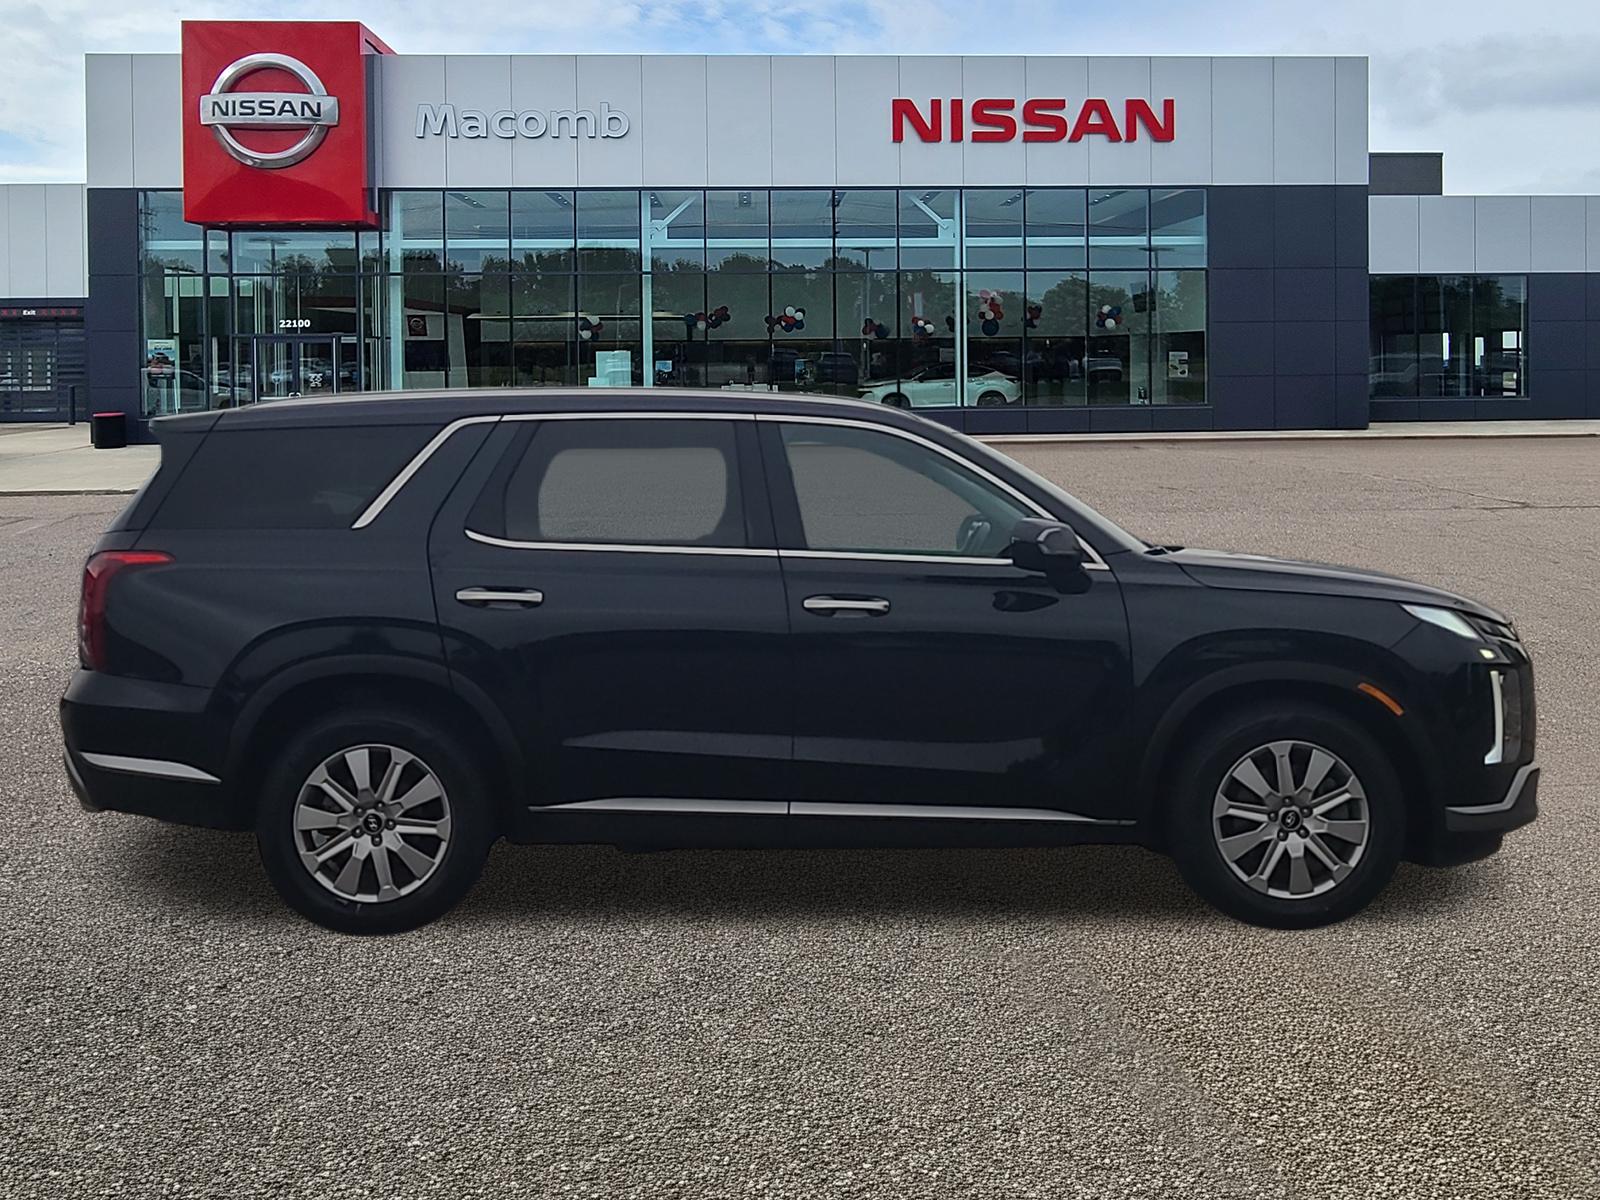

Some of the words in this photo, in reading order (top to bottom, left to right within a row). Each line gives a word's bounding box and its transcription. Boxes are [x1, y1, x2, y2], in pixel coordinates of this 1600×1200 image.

[212, 100, 321, 118] NISSAN
[415, 102, 630, 138] Macomb
[892, 98, 1175, 143] NISSAN
[279, 319, 311, 328] 22100
